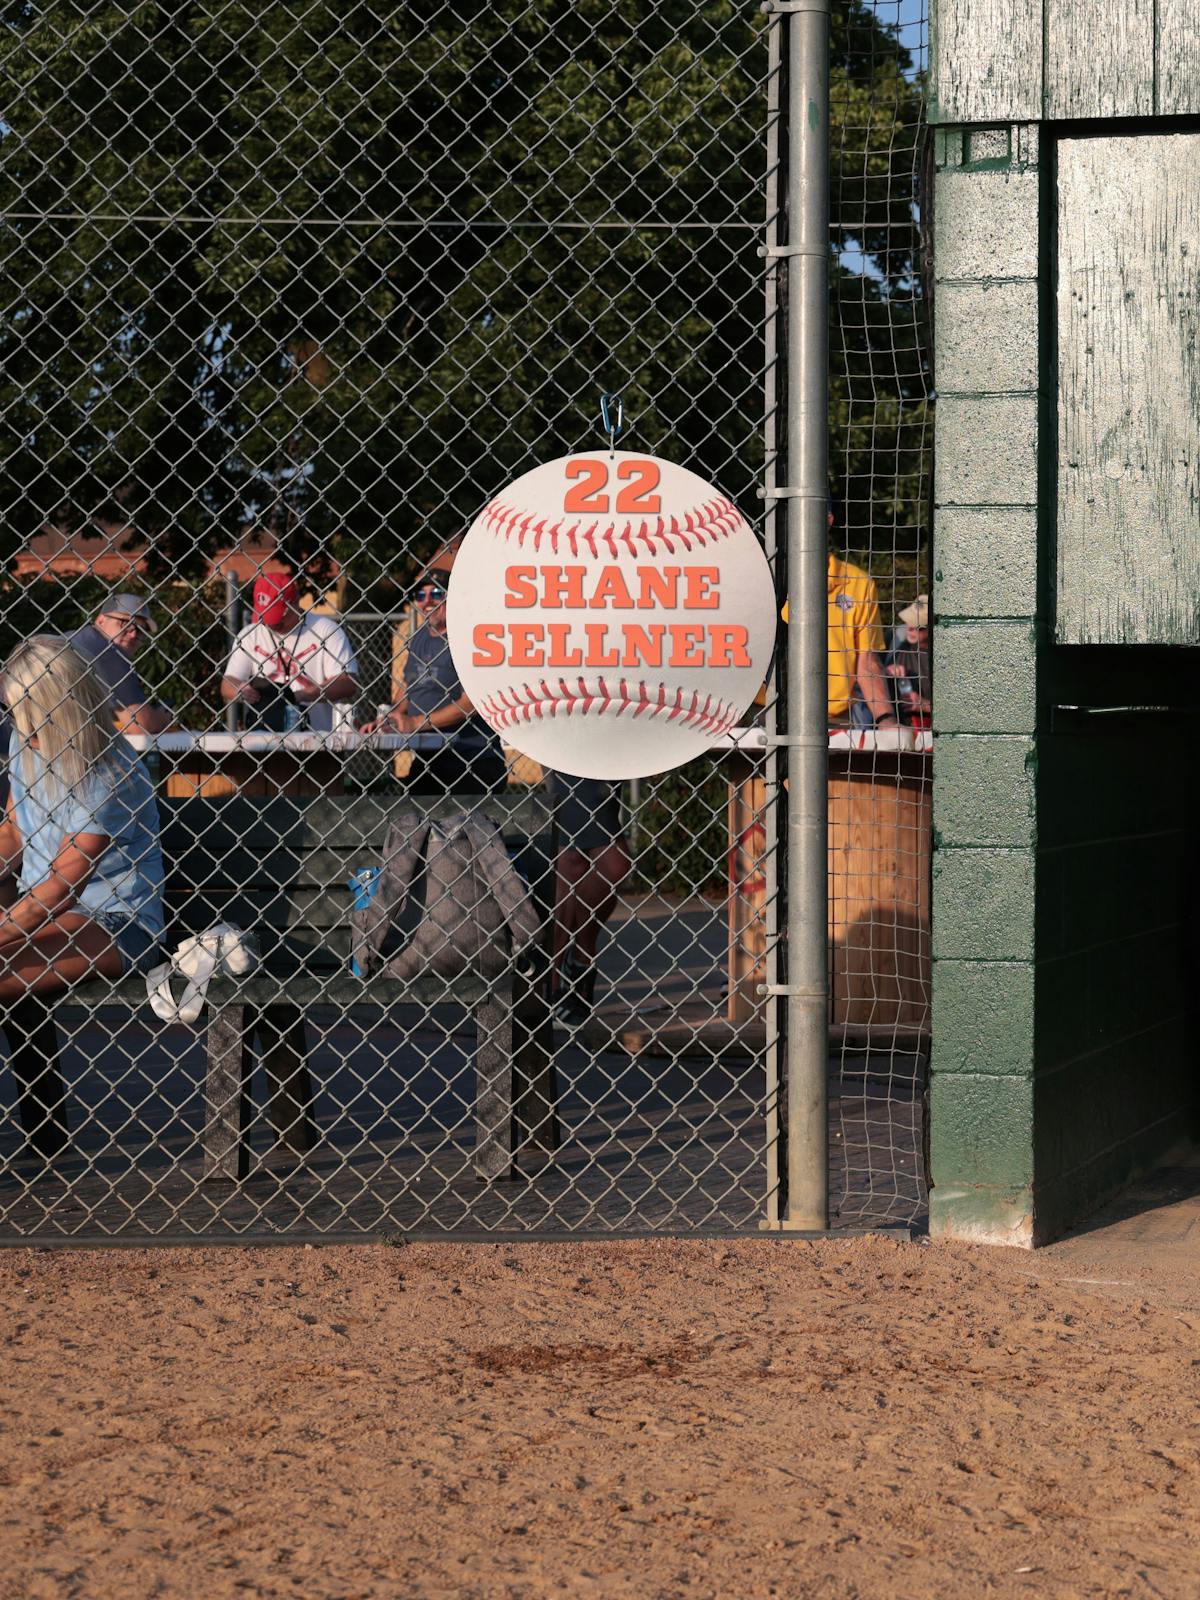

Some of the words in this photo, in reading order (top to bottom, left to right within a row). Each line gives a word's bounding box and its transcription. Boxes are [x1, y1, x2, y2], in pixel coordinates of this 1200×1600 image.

[564, 460, 661, 514] 22
[505, 565, 720, 609] SHANE
[472, 624, 752, 668] SELLNER
